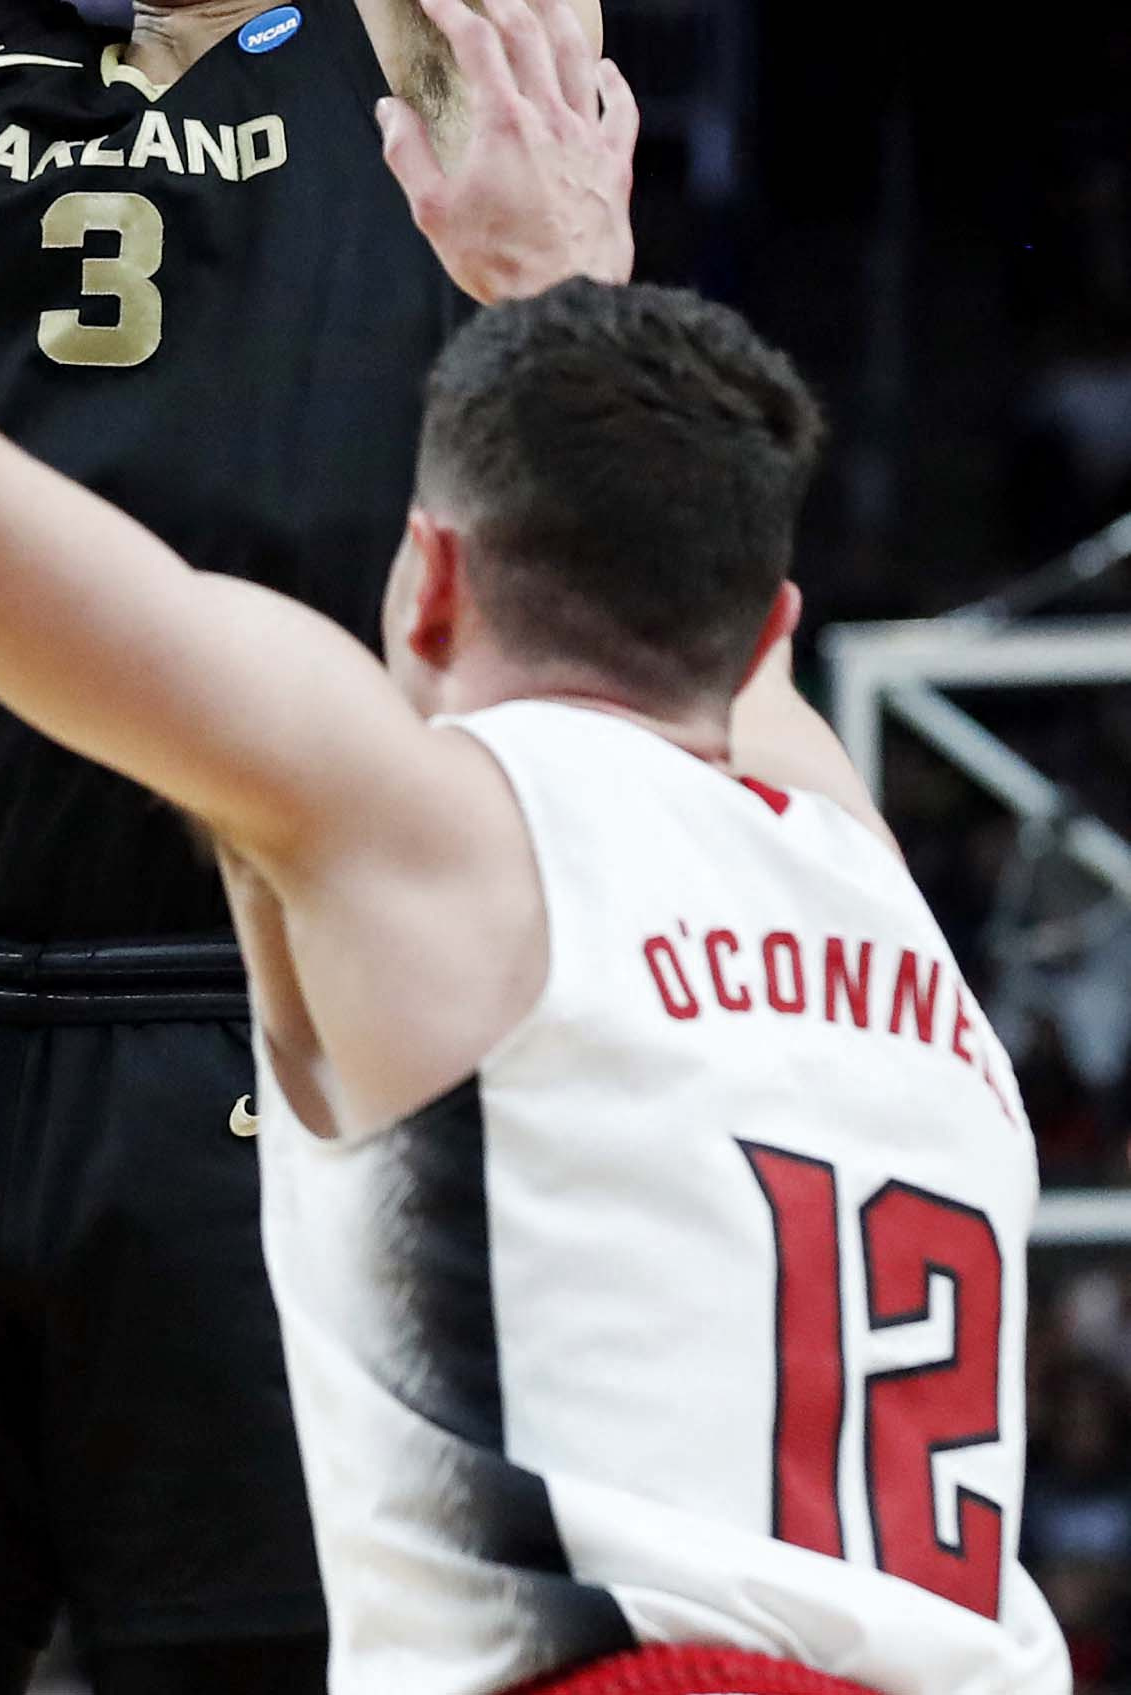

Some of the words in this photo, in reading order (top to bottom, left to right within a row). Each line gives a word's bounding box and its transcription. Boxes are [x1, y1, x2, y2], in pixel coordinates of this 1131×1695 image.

[247, 17, 298, 47] NCAA
[37, 191, 164, 366] 3
[644, 919, 1018, 1130] O'CONNE
[734, 1137, 1003, 1623] 12
